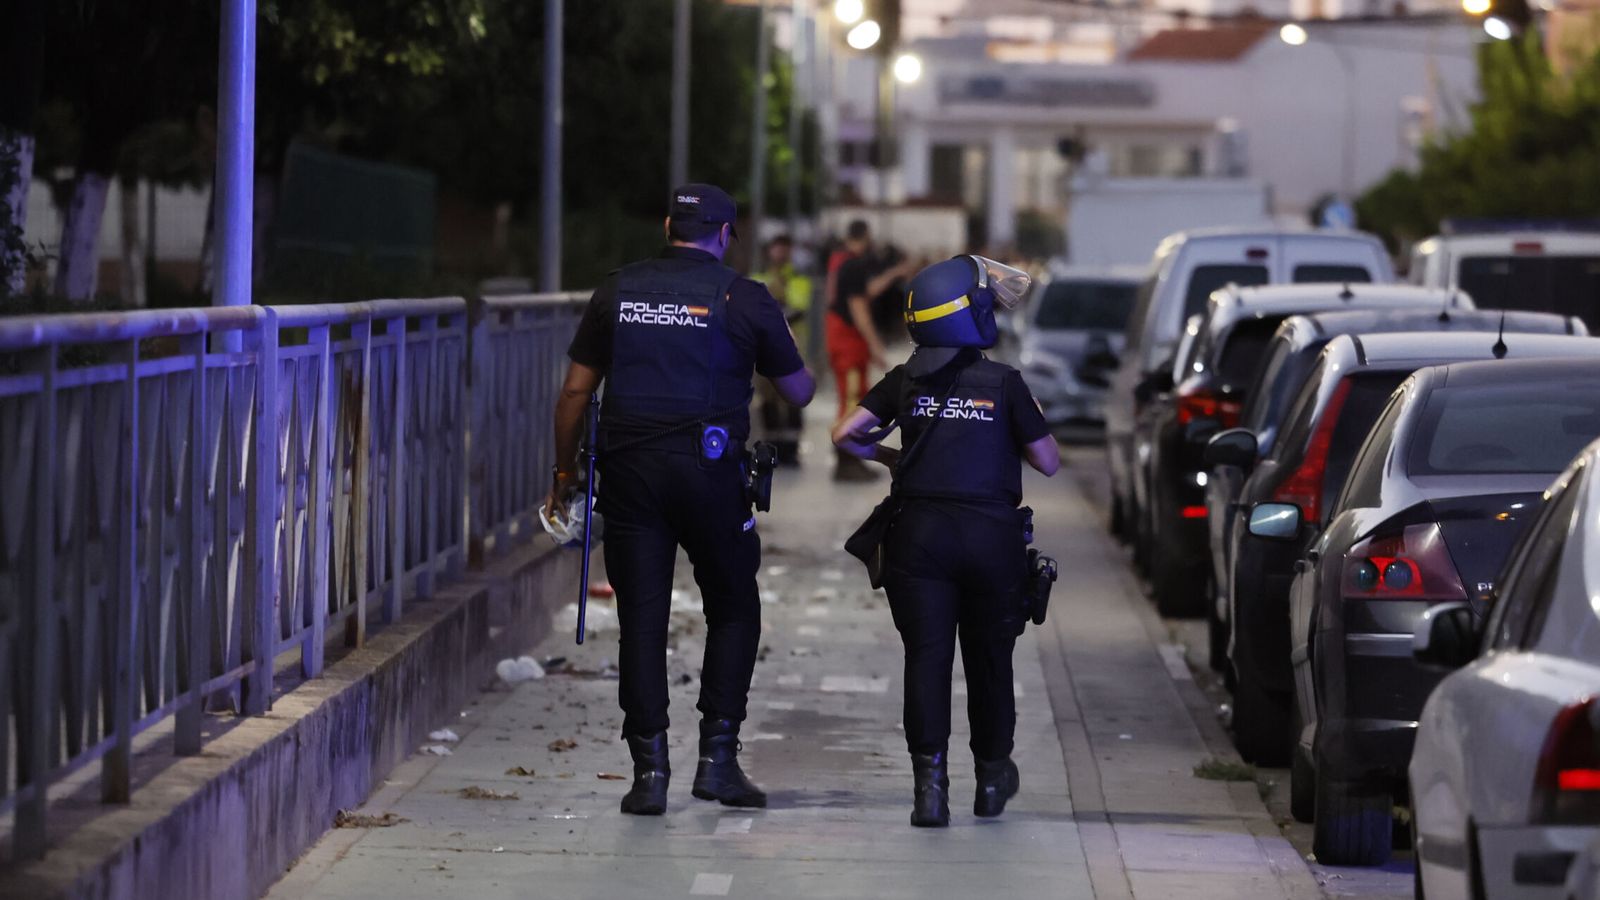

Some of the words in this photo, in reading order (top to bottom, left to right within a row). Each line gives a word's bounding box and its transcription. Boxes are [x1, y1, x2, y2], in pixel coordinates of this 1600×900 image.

[620, 301, 690, 315] POLICIA
[619, 312, 708, 328] NACIONAL
[913, 396, 975, 409] OLCIA
